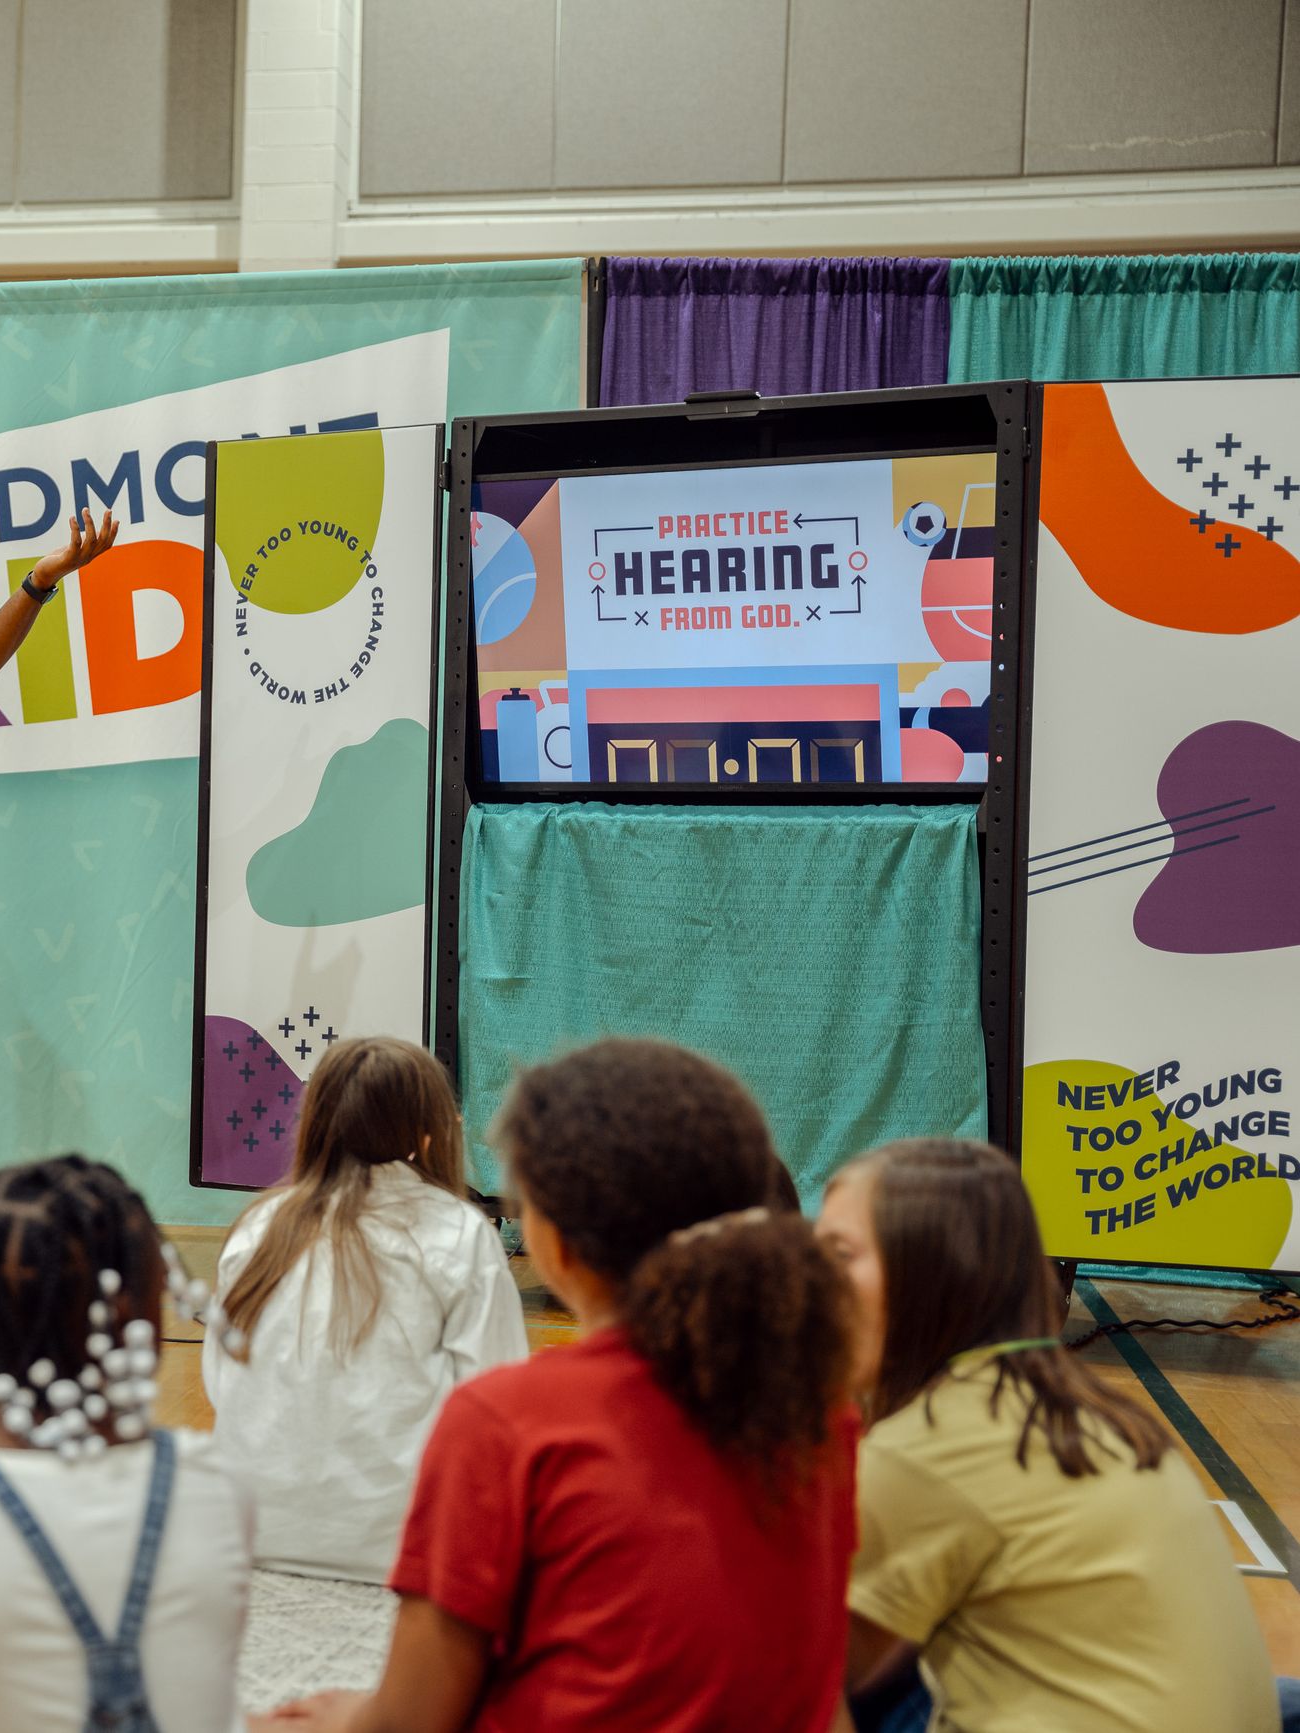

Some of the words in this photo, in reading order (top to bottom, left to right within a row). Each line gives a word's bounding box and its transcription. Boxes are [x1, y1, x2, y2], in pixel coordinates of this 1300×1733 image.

[256, 527, 292, 560] TOO
[297, 520, 359, 552] YOUNG
[658, 510, 789, 539] PRACTICE
[359, 550, 378, 579] TO
[614, 543, 840, 596] HEARING
[235, 563, 259, 637] NEVER
[660, 606, 732, 631] FROM
[741, 604, 800, 629] GOD.
[349, 586, 384, 679] CHANGE
[249, 661, 307, 705] WORLD
[313, 677, 350, 704] THE
[1057, 1060, 1181, 1111] NEVER
[1066, 1119, 1142, 1152] TOO
[1151, 1067, 1282, 1132] YOUNG
[1075, 1166, 1124, 1194] TO
[1133, 1110, 1290, 1181] CHANGE
[1085, 1192, 1156, 1235] THE
[1165, 1152, 1300, 1209] WORLD
